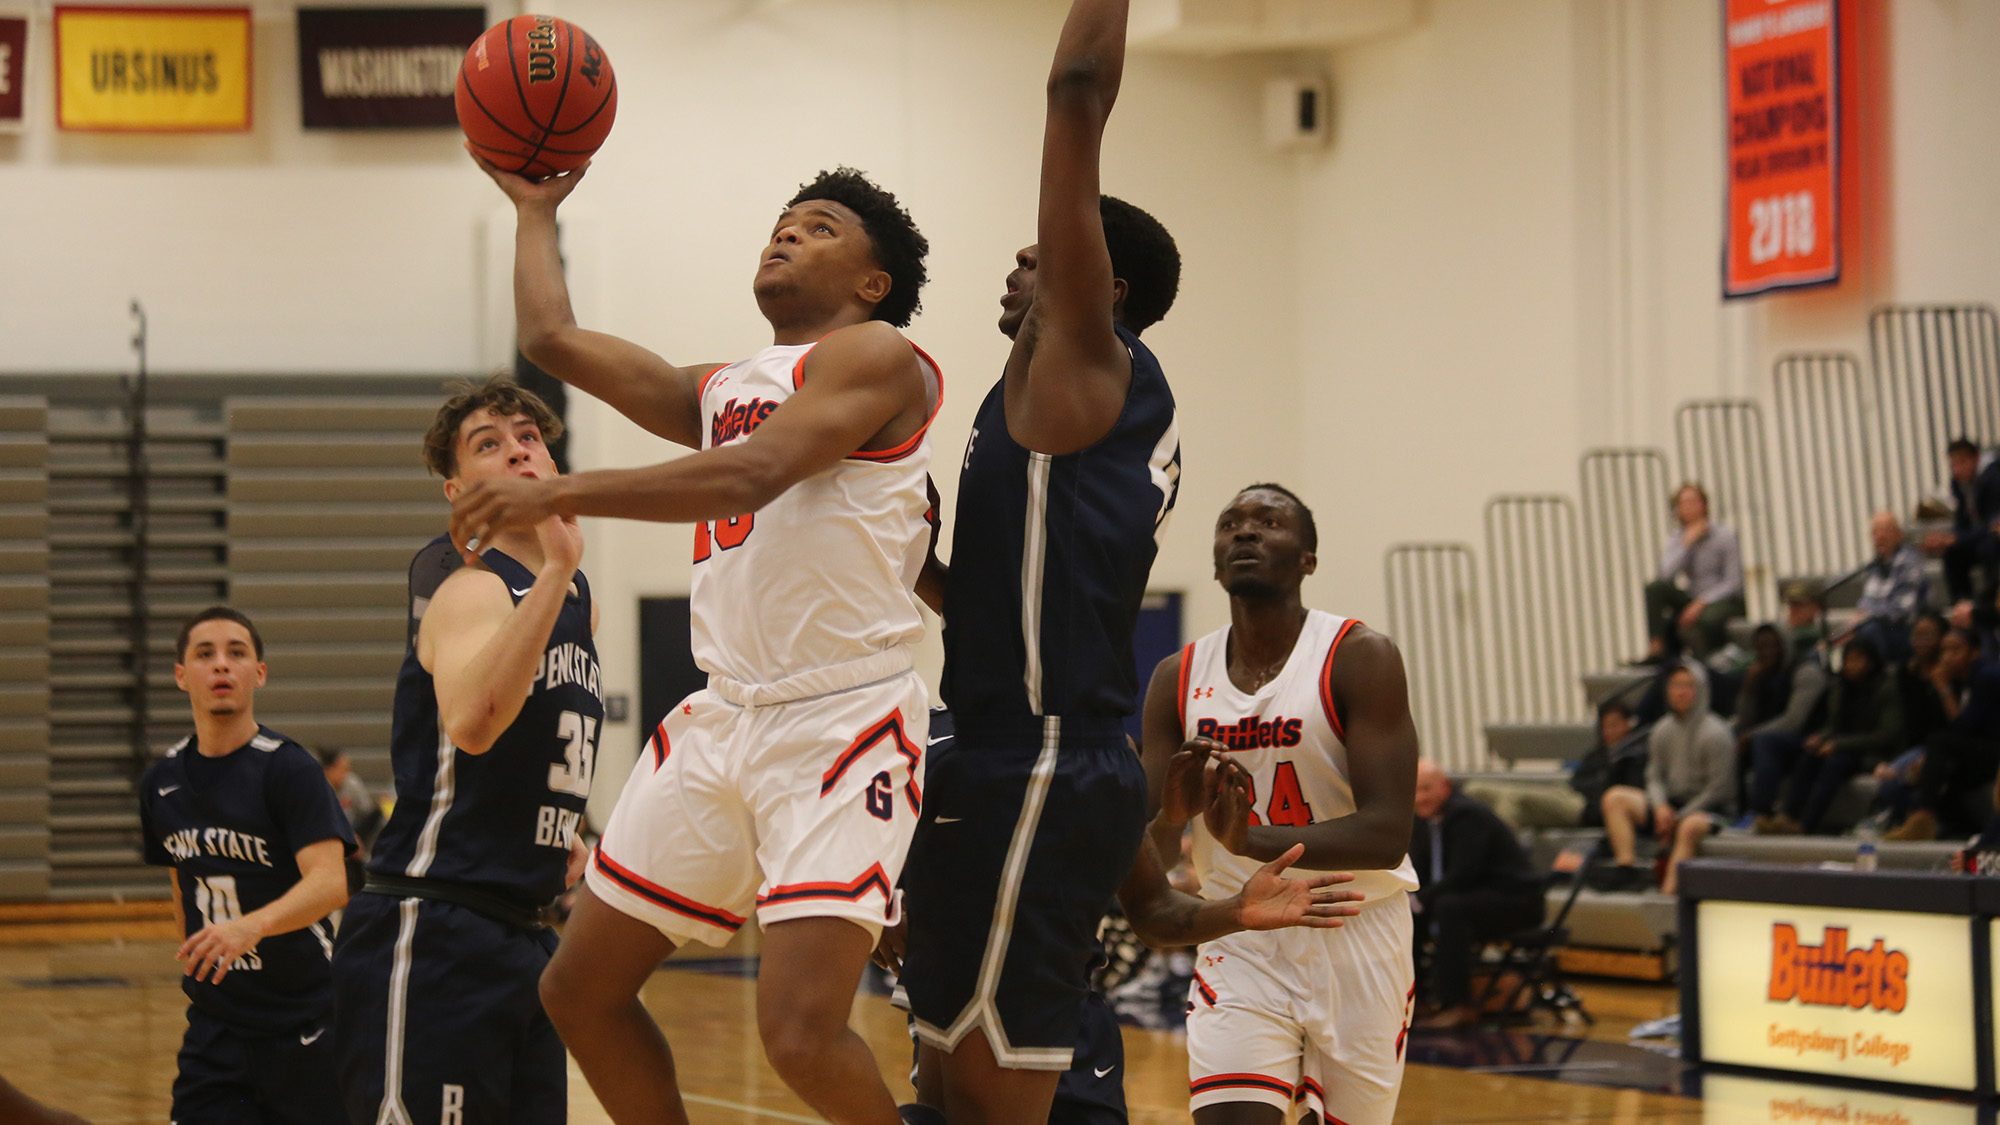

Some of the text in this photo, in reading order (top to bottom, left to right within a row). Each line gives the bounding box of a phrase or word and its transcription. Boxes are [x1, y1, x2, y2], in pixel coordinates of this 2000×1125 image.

[90, 48, 219, 95] URSINUS
[527, 14, 558, 85] Wilso
[579, 31, 602, 88] NC
[1748, 190, 1817, 265] 2018
[547, 709, 598, 800] 35
[1197, 715, 1303, 752] Bullets
[866, 771, 893, 821] G
[1218, 761, 1316, 827] 4
[204, 827, 273, 868] STATE
[1768, 922, 1910, 1014] Bullets
[1767, 1024, 1911, 1067] Gettysburg College
